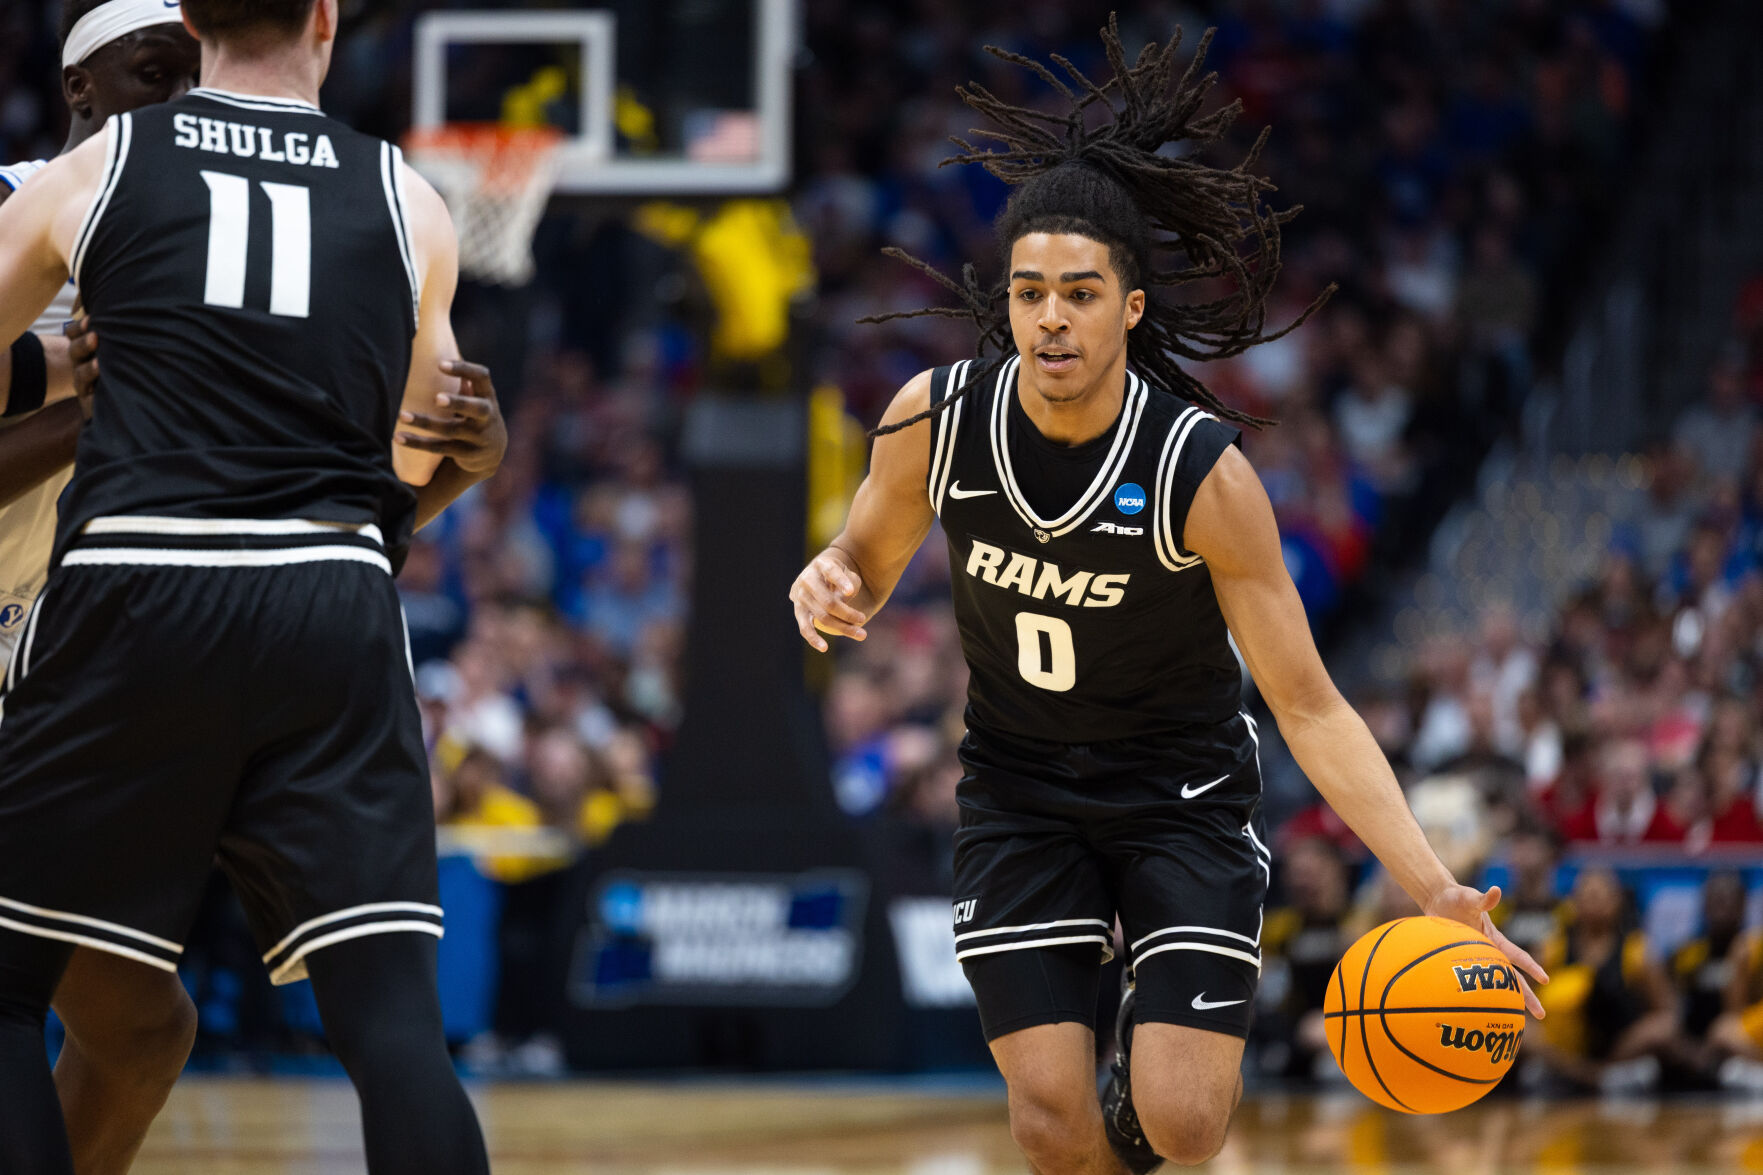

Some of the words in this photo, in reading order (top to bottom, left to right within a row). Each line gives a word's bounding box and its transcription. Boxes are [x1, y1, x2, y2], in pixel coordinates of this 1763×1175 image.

[173, 112, 340, 170] SHULGA
[199, 169, 311, 319] 11
[1118, 497, 1144, 507] NCAA
[966, 540, 1131, 608] RAMS
[1014, 611, 1077, 692] 0
[1452, 964, 1521, 994] NCAA
